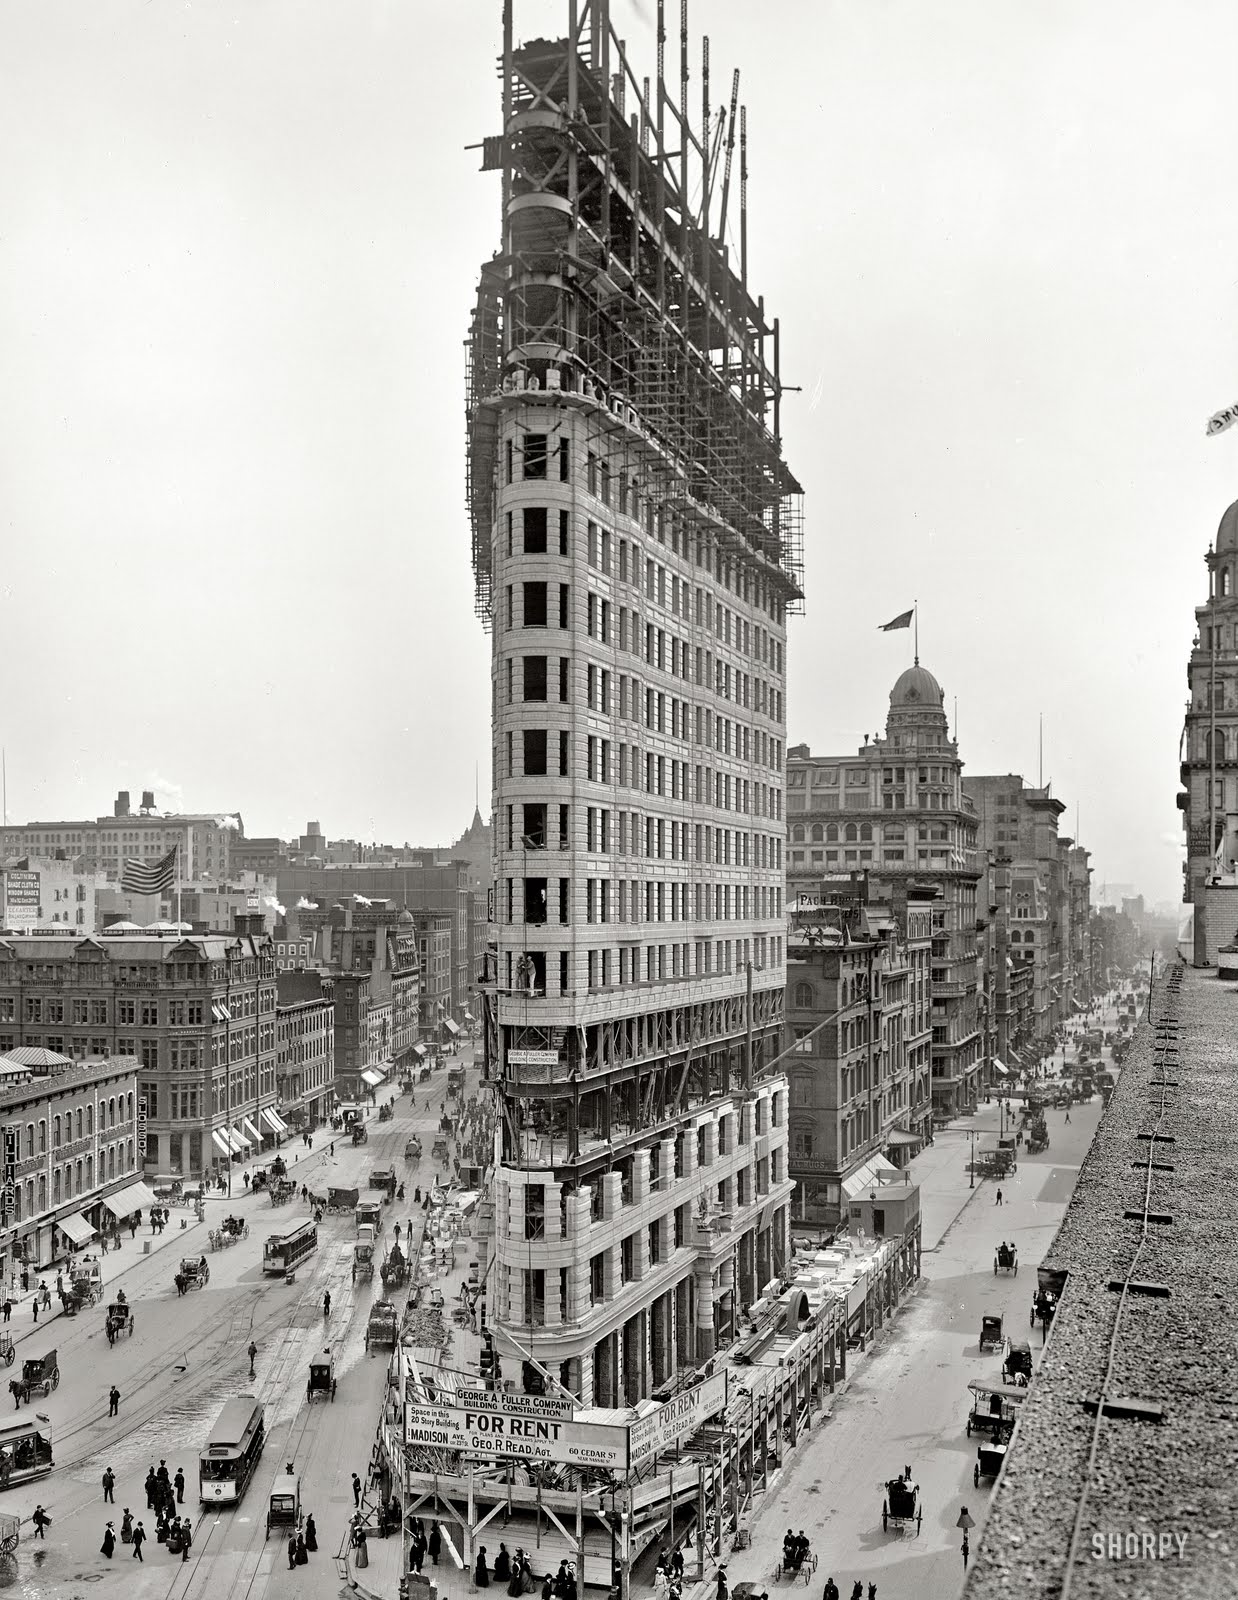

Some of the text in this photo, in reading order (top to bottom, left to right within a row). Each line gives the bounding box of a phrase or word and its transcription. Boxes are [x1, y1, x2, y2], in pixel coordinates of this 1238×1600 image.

[800, 895, 826, 905] PACH
[5, 1126, 14, 1215] BILLIARDS
[458, 1390, 571, 1410] GEORGE A. FULLER COMPANY
[659, 1403, 676, 1427] FOR
[678, 1388, 701, 1415] RENT
[411, 1407, 430, 1416] Space
[438, 1410, 449, 1418] this
[464, 1400, 564, 1417] BUILDING CONSTRUCTION.
[421, 1417, 435, 1428] Story
[436, 1419, 460, 1430] Building
[466, 1413, 562, 1440] FOR RENT
[411, 1429, 448, 1444] MADISON
[581, 1449, 606, 1458] CEDAR
